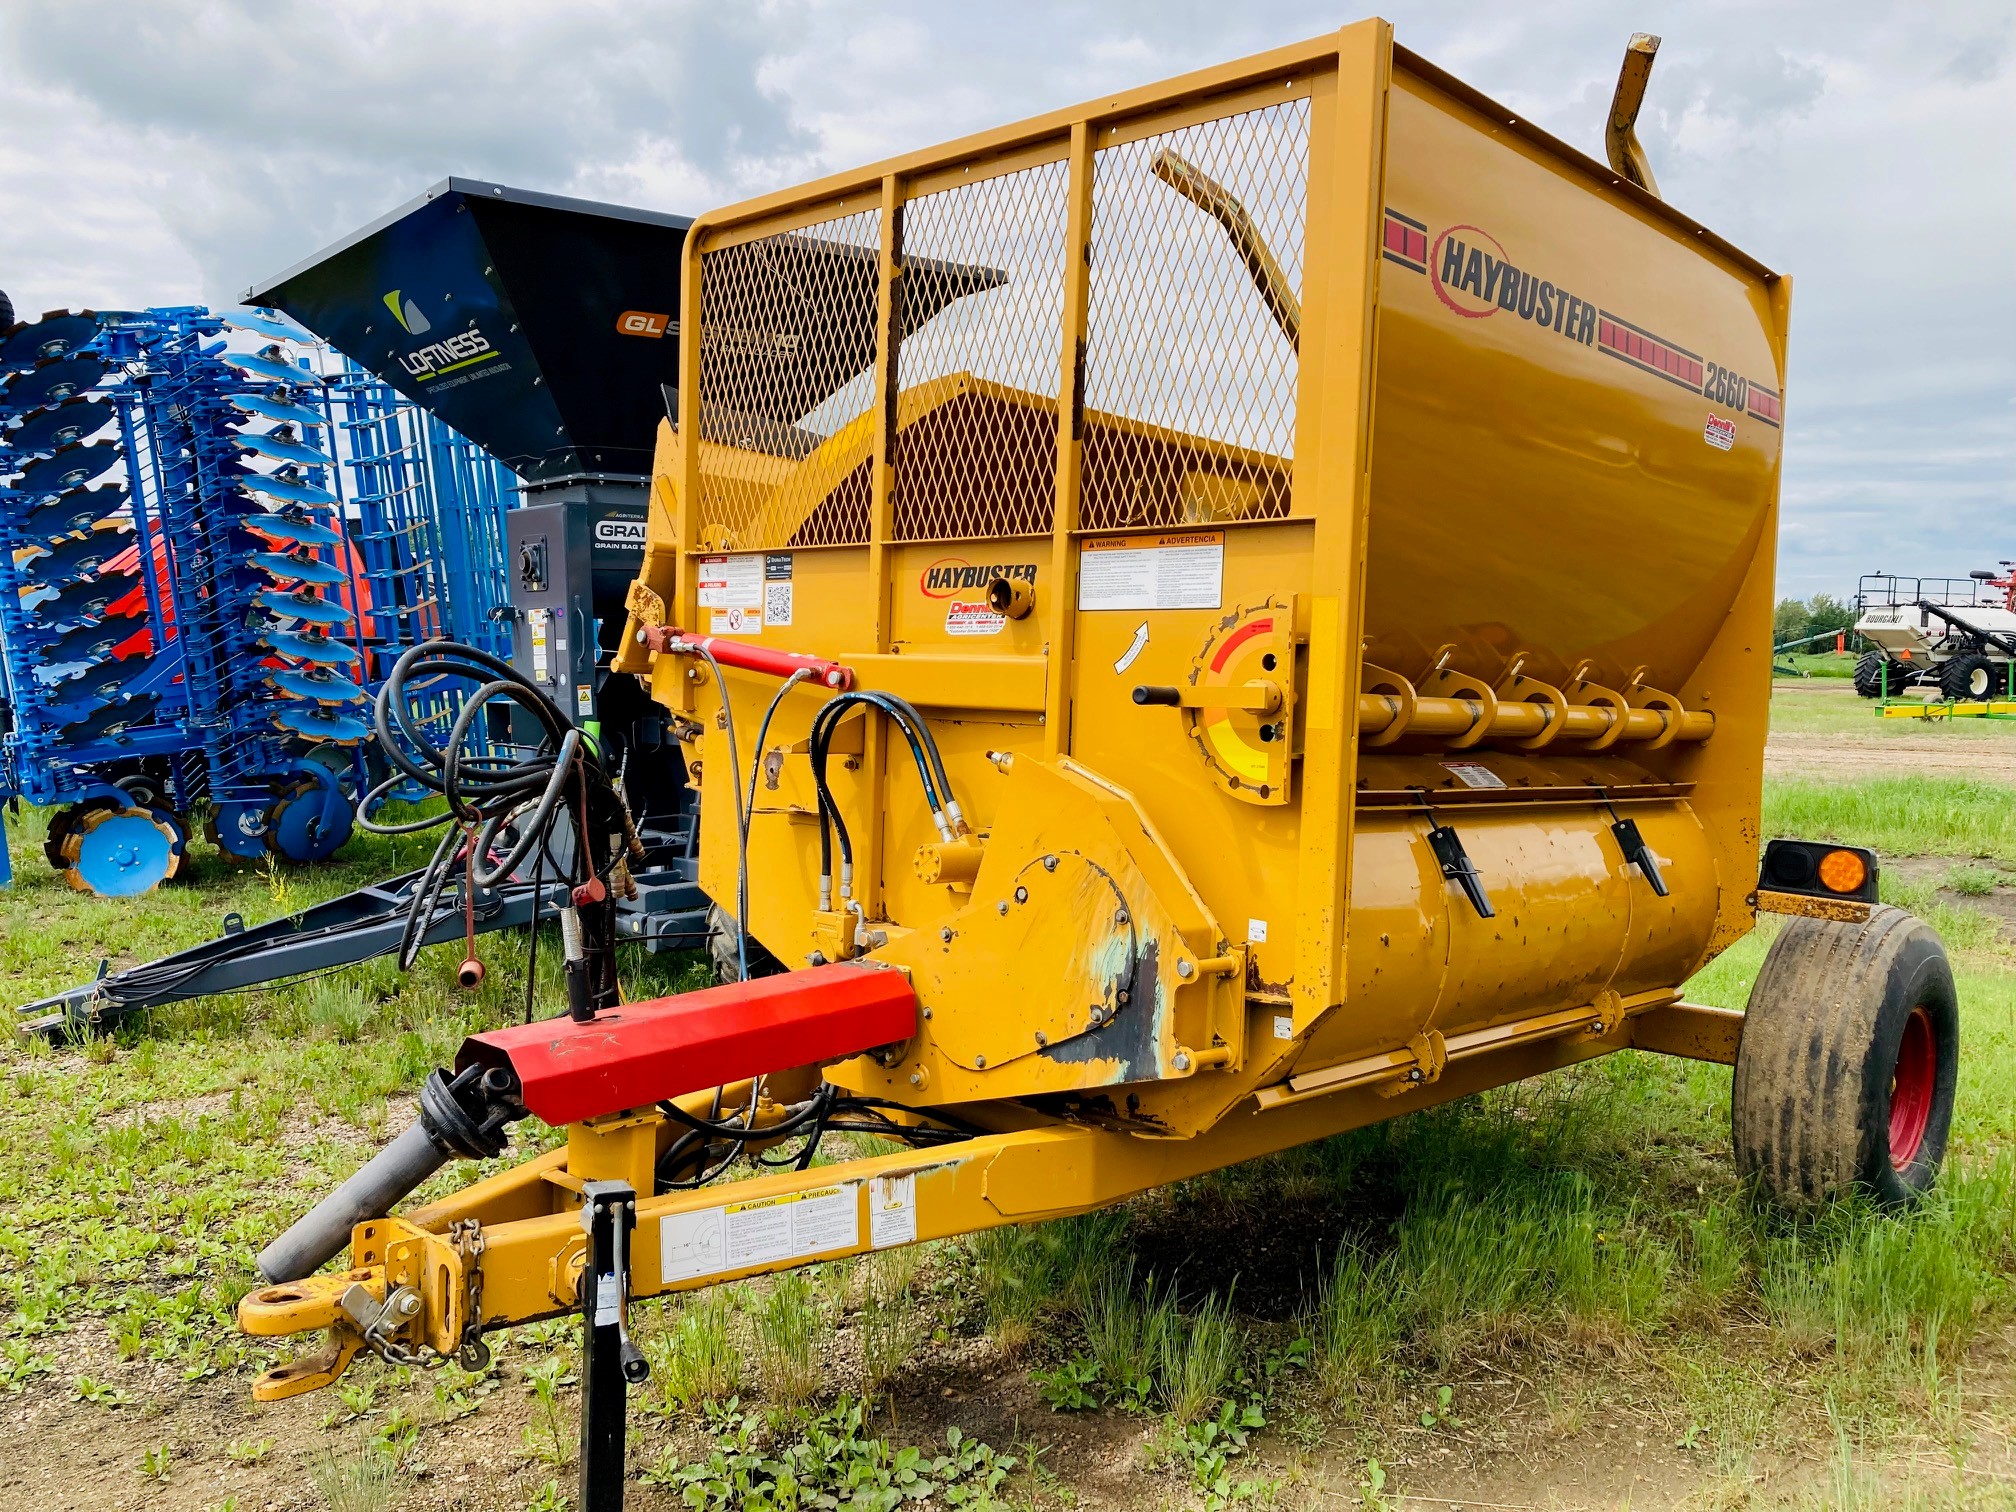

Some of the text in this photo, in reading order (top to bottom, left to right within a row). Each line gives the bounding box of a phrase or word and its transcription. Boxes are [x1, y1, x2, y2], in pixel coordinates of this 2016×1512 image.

[1441, 236, 1597, 346] HAYBUSTER
[624, 315, 662, 333] GL
[398, 329, 490, 375] LOFTNESS
[1704, 361, 1747, 412] 2660
[600, 525, 645, 538] GRAI
[1167, 535, 1216, 545] ADVERTENCIA
[1095, 540, 1126, 548] WARNING
[927, 564, 1038, 589] HAYBUSTER
[748, 1200, 776, 1210] CAUTION
